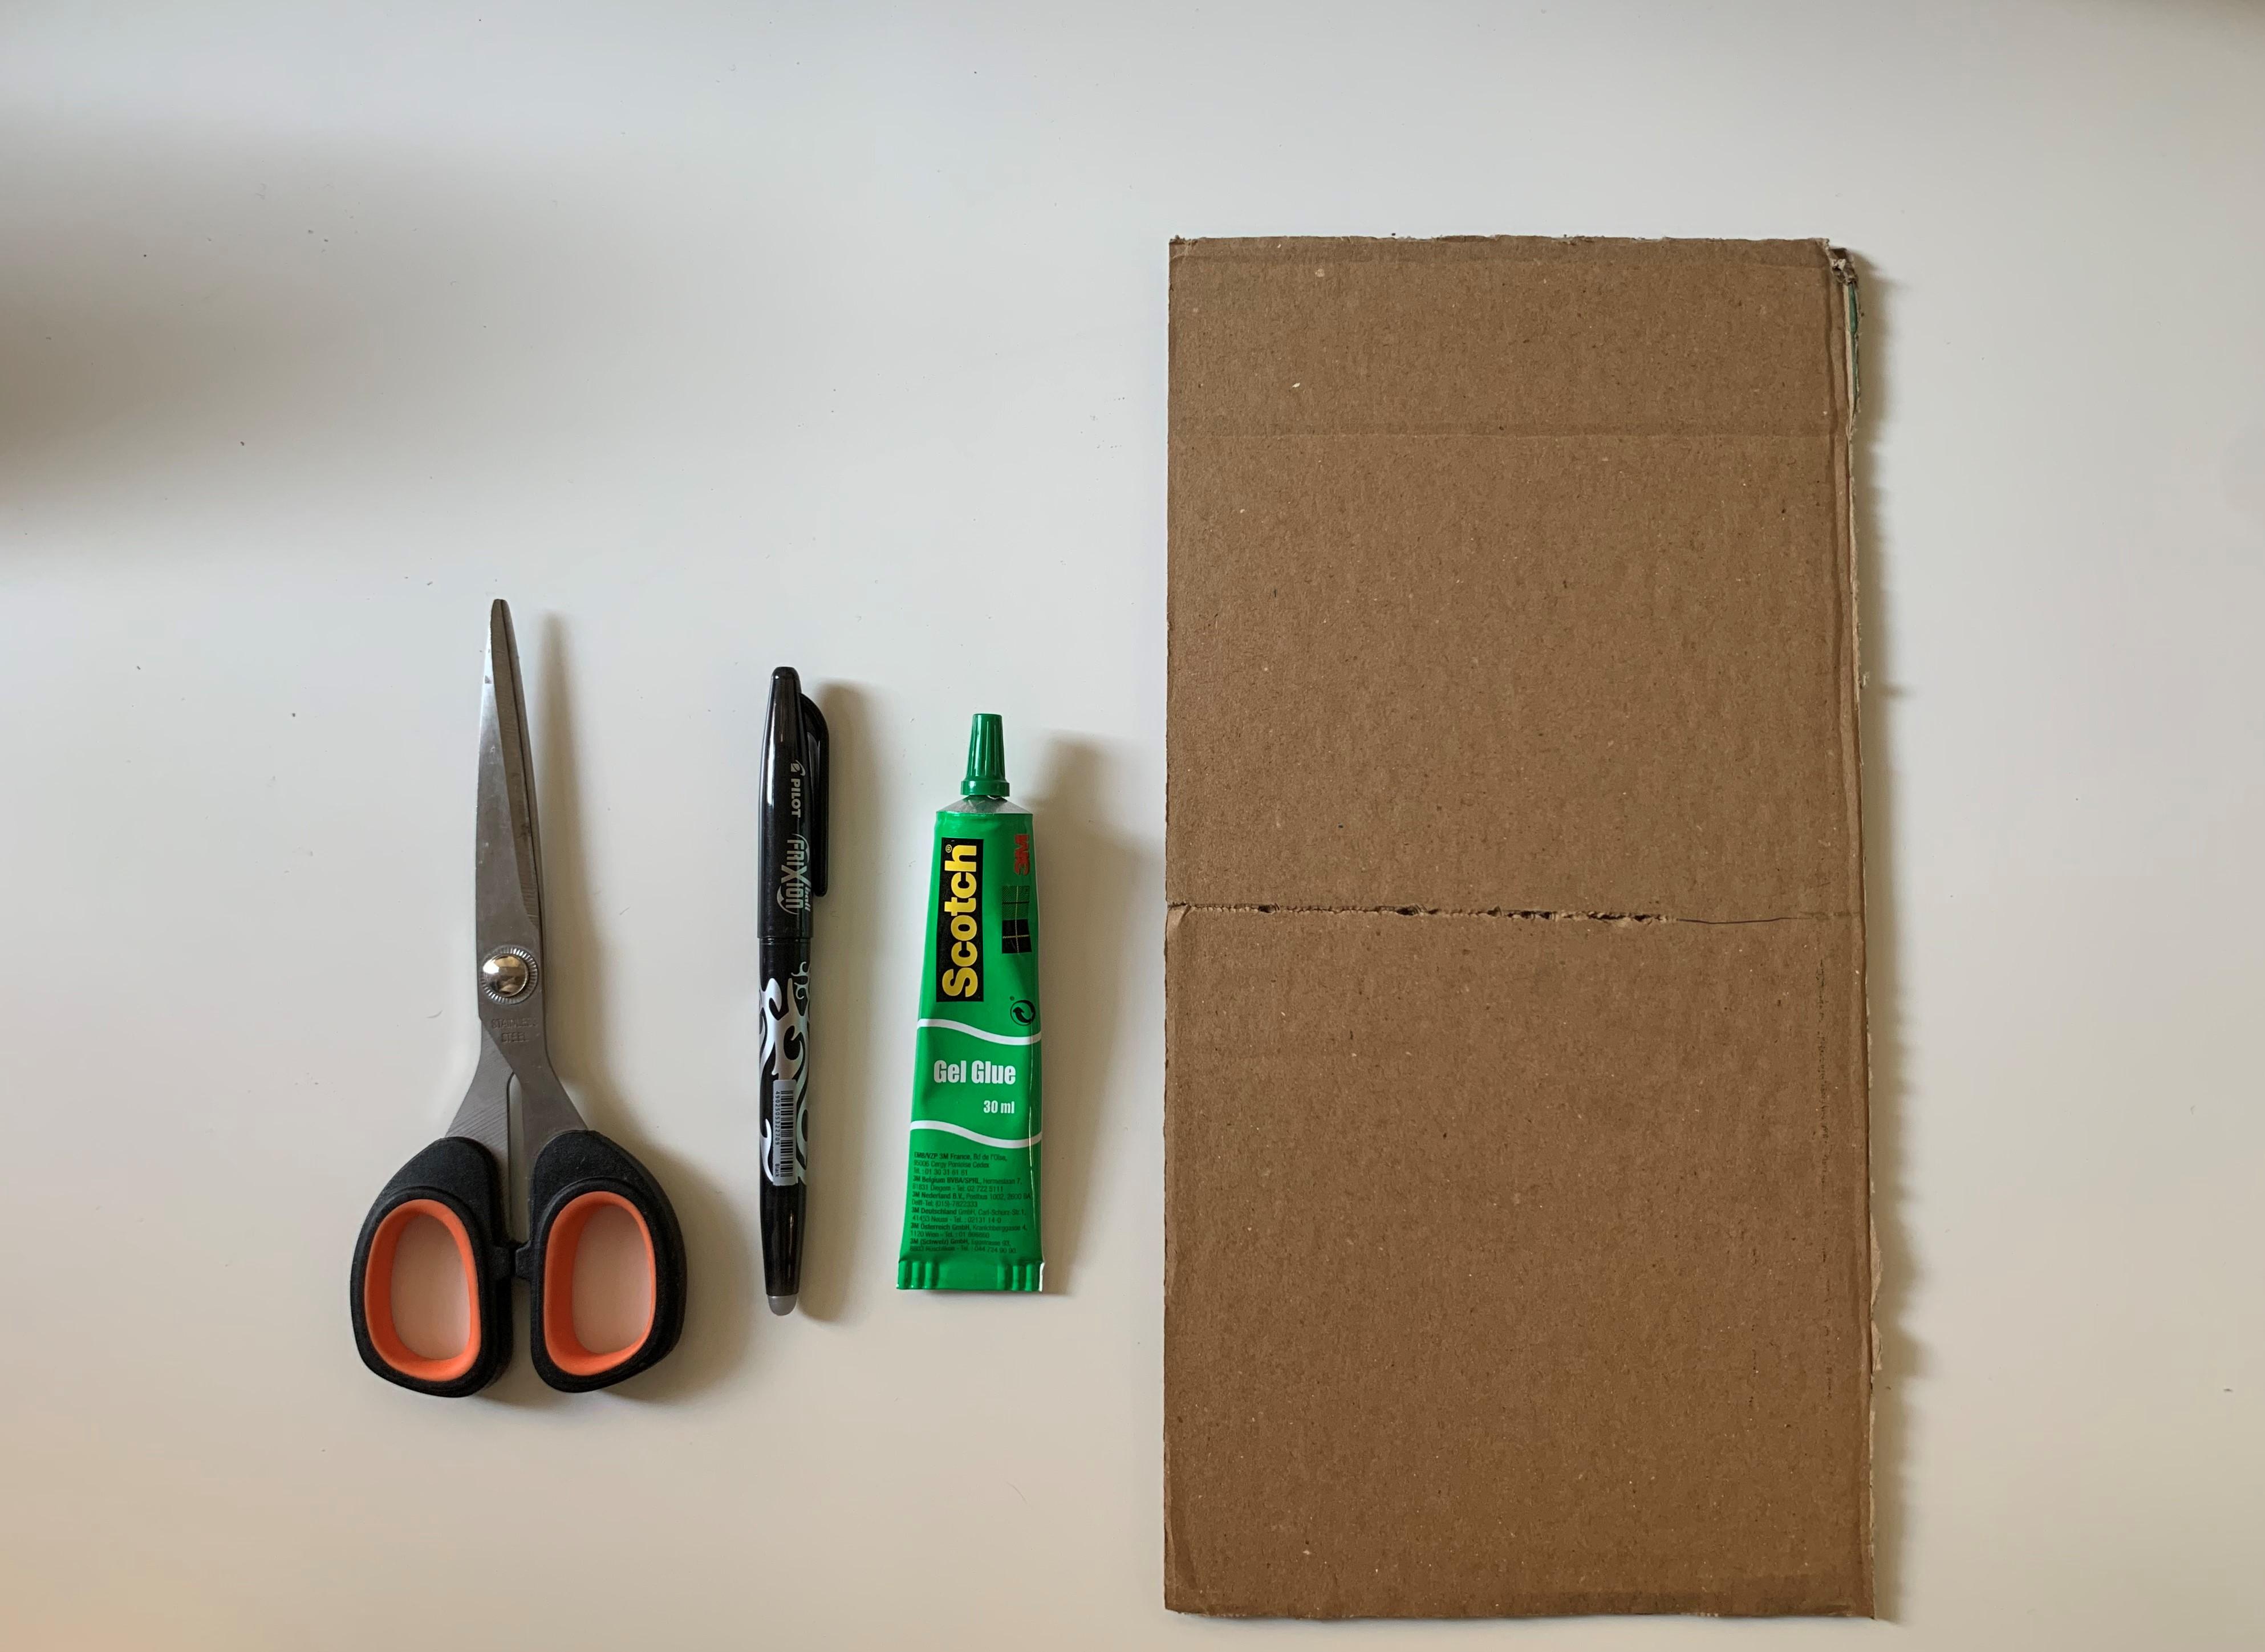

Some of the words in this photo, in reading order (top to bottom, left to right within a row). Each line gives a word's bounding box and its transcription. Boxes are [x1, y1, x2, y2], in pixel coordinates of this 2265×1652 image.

[790, 778, 801, 818] PILOT
[1013, 834, 1030, 876] 3M
[933, 1060, 967, 1083] Gel
[971, 1060, 1016, 1085] Glue
[983, 1100, 998, 1114] 30
[1000, 1101, 1015, 1114] ml
